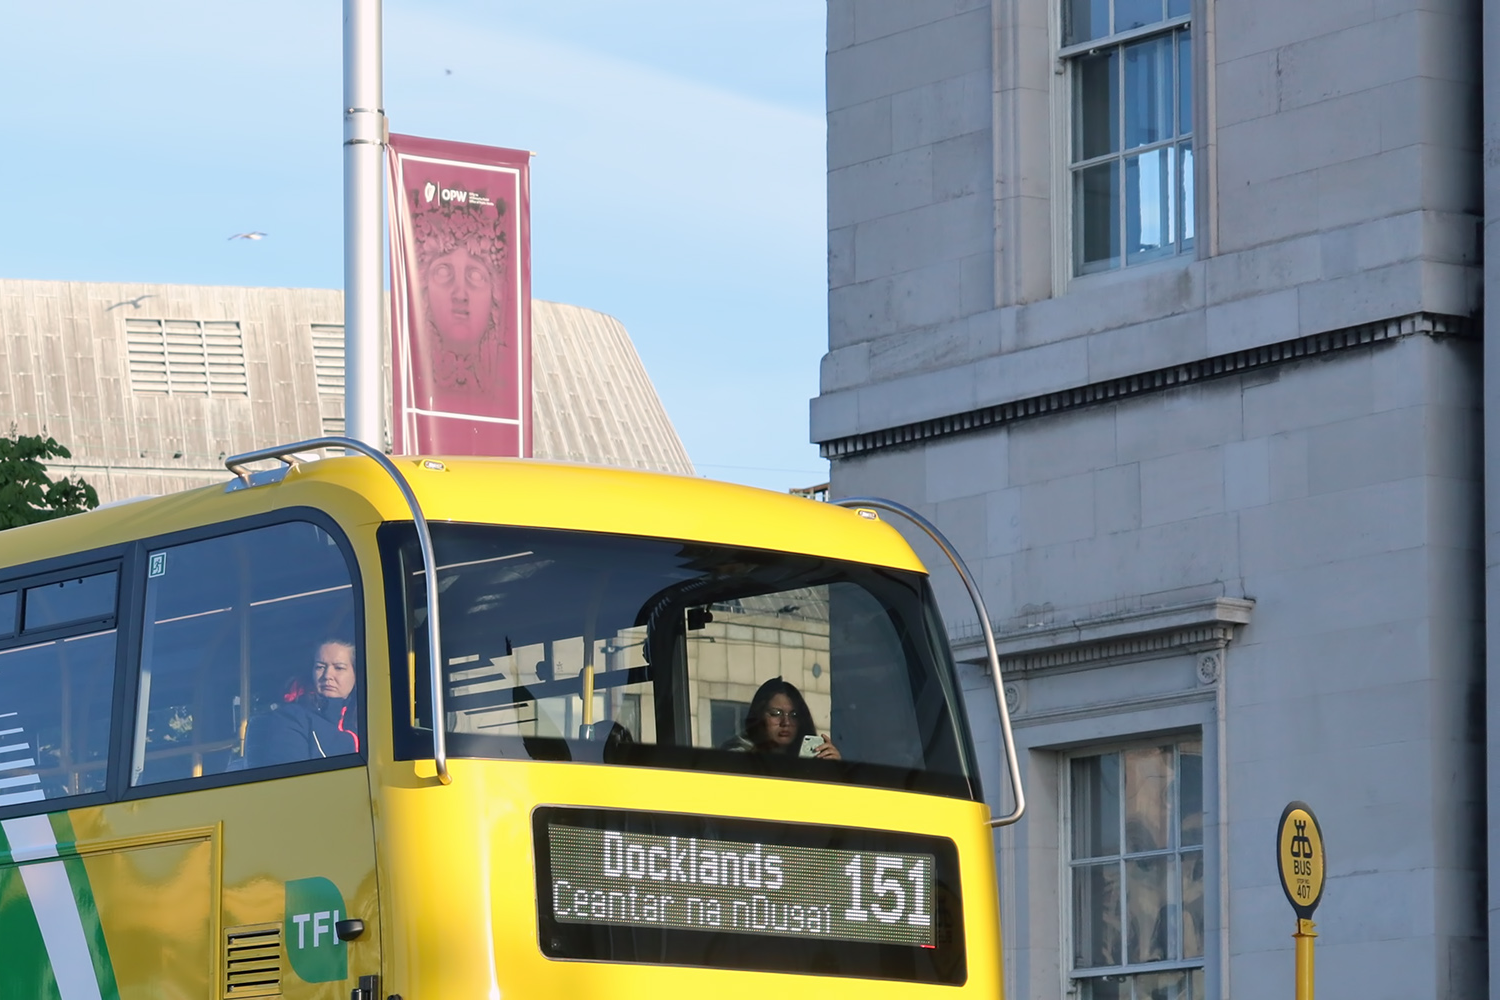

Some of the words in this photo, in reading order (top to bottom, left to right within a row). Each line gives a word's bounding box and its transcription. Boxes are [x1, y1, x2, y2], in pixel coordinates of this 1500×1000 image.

[441, 188, 467, 203] OPW
[603, 831, 783, 889] Docklands
[844, 854, 931, 926] 151
[1293, 860, 1312, 876] BUS
[553, 880, 675, 922] Ceantar
[686, 897, 721, 926] na
[1297, 884, 1311, 899] 407
[293, 910, 340, 949] TFI
